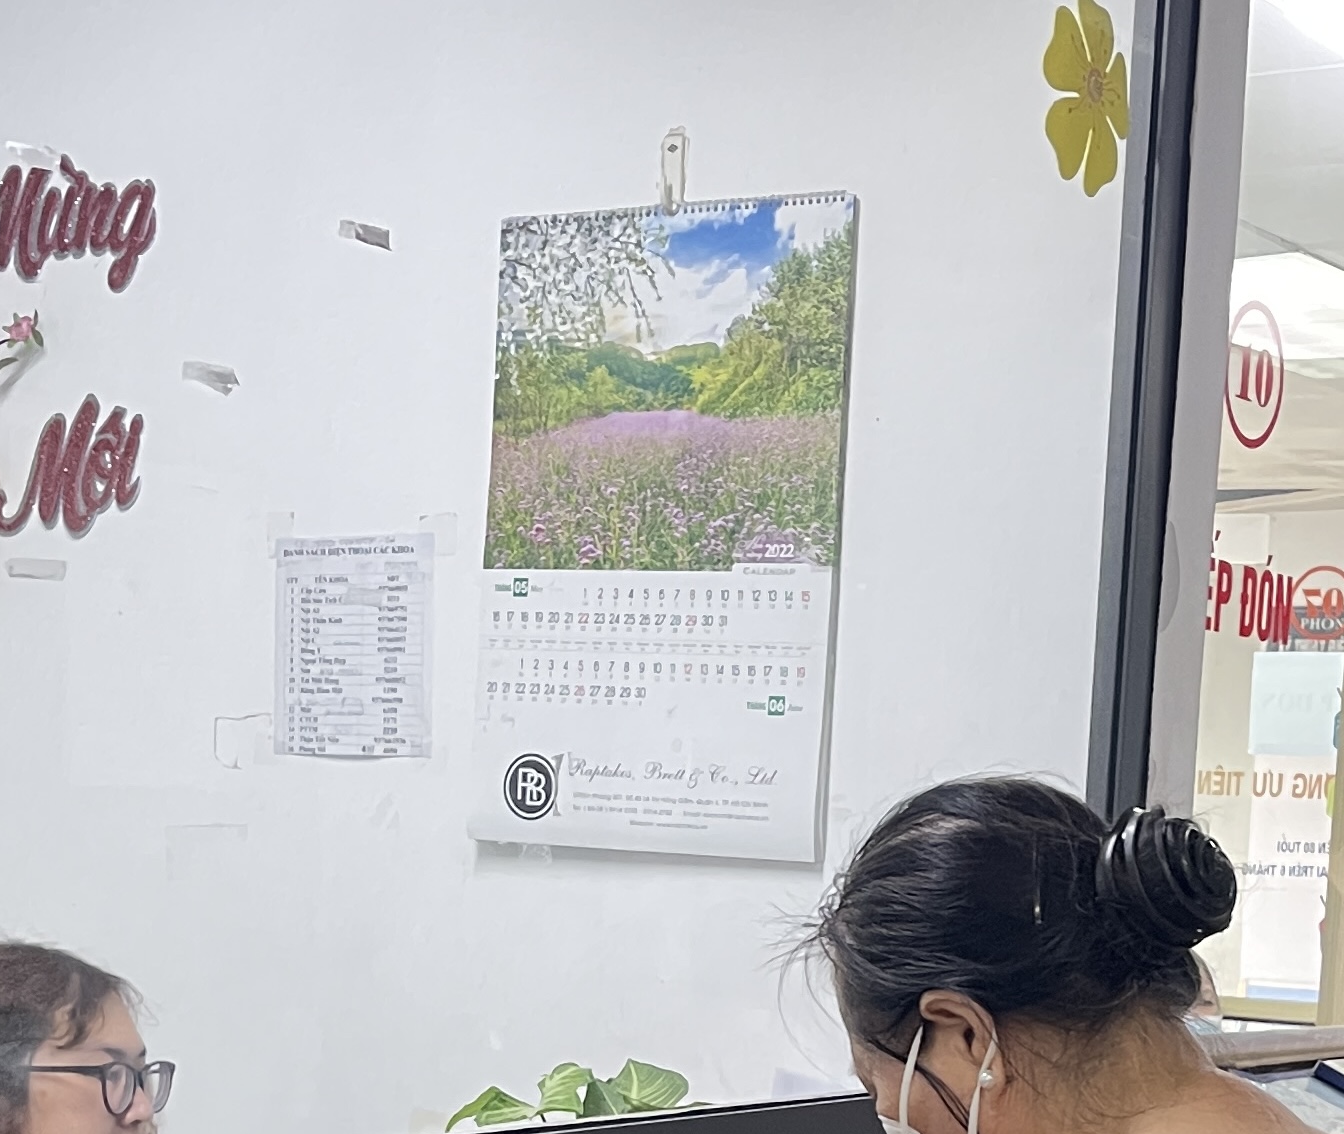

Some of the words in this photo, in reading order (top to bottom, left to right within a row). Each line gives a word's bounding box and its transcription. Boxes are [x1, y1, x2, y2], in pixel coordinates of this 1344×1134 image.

[1235, 343, 1274, 407] 10
[764, 544, 795, 558] 2022
[514, 581, 528, 594] 05
[583, 588, 588, 599] 1
[720, 590, 730, 601] 10
[751, 590, 761, 602] 12
[1239, 555, 1293, 645] ĐÓN
[769, 699, 784, 712] 06
